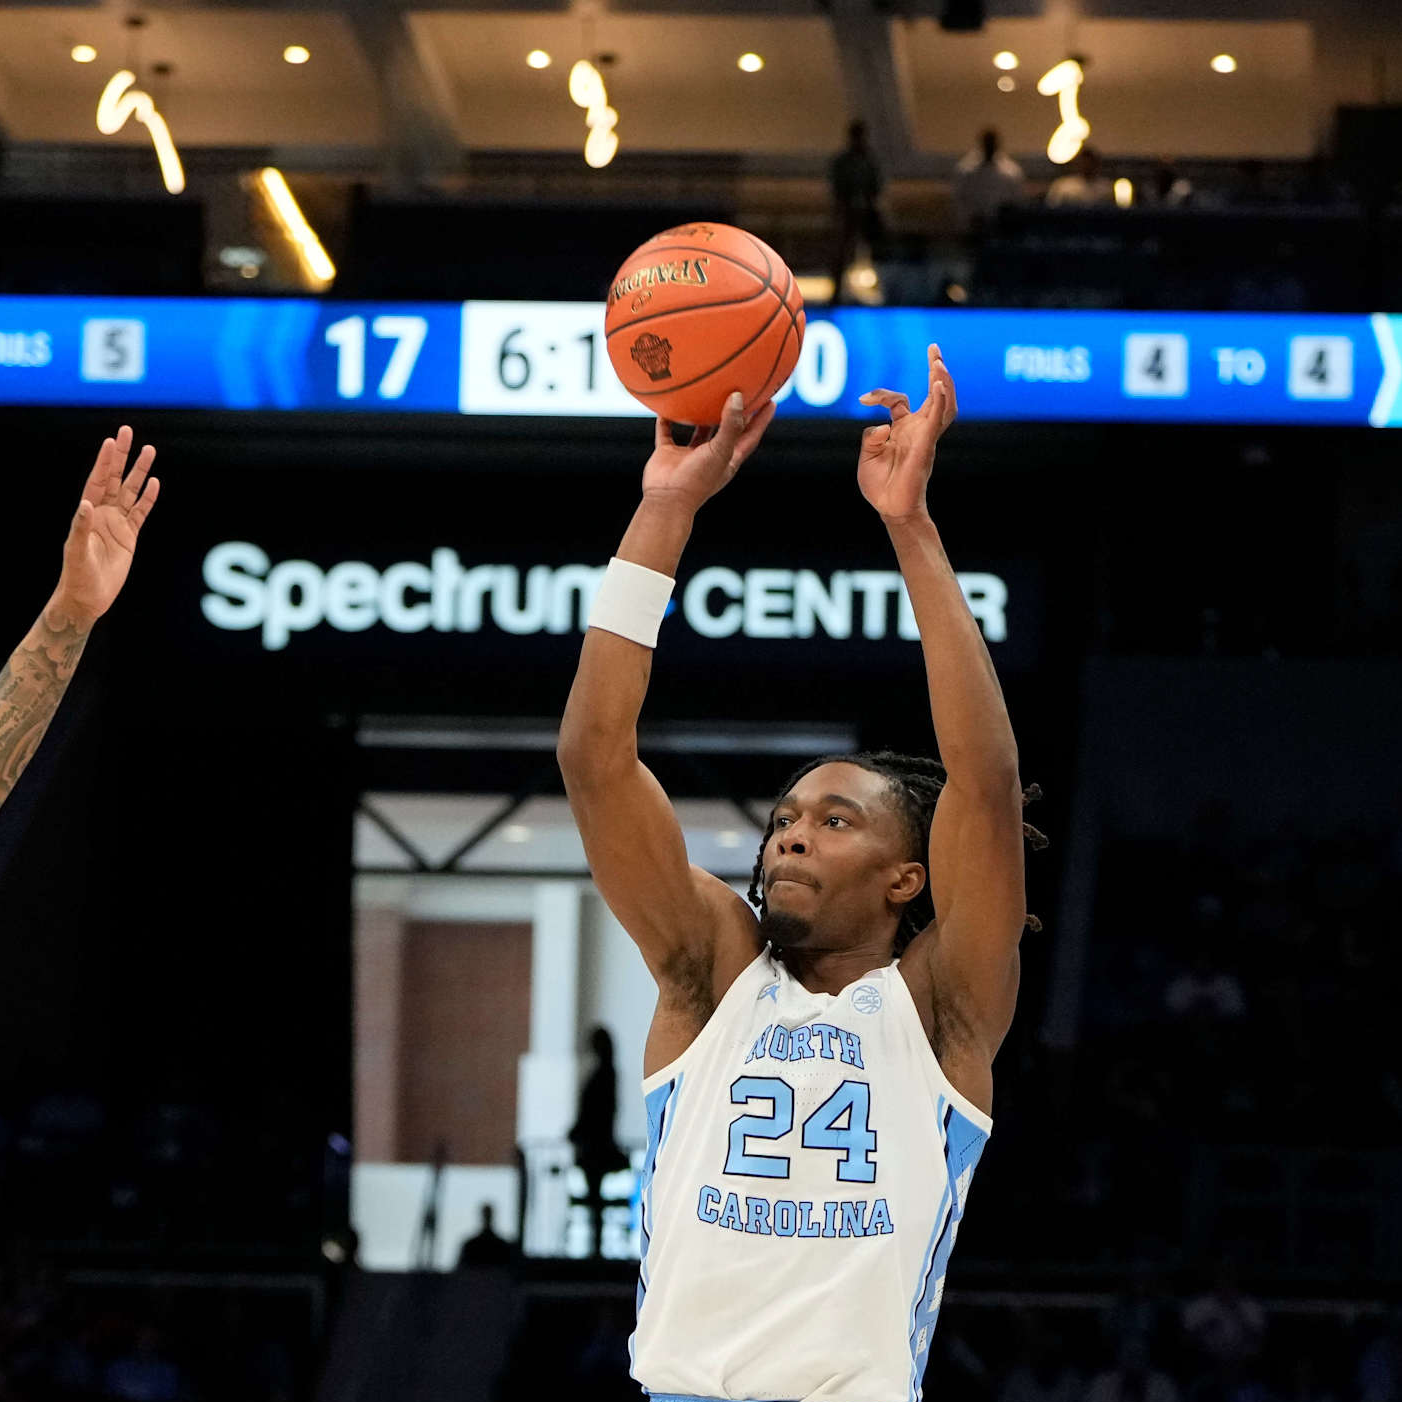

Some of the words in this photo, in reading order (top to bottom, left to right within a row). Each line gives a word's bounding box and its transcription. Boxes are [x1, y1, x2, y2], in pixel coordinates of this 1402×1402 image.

[325, 315, 428, 400] 17
[497, 327, 598, 394] 6:1
[1212, 347, 1267, 386] TO
[745, 1023, 865, 1070] NORTH
[722, 1075, 878, 1184] 24
[697, 1185, 895, 1239] CAROLINA
